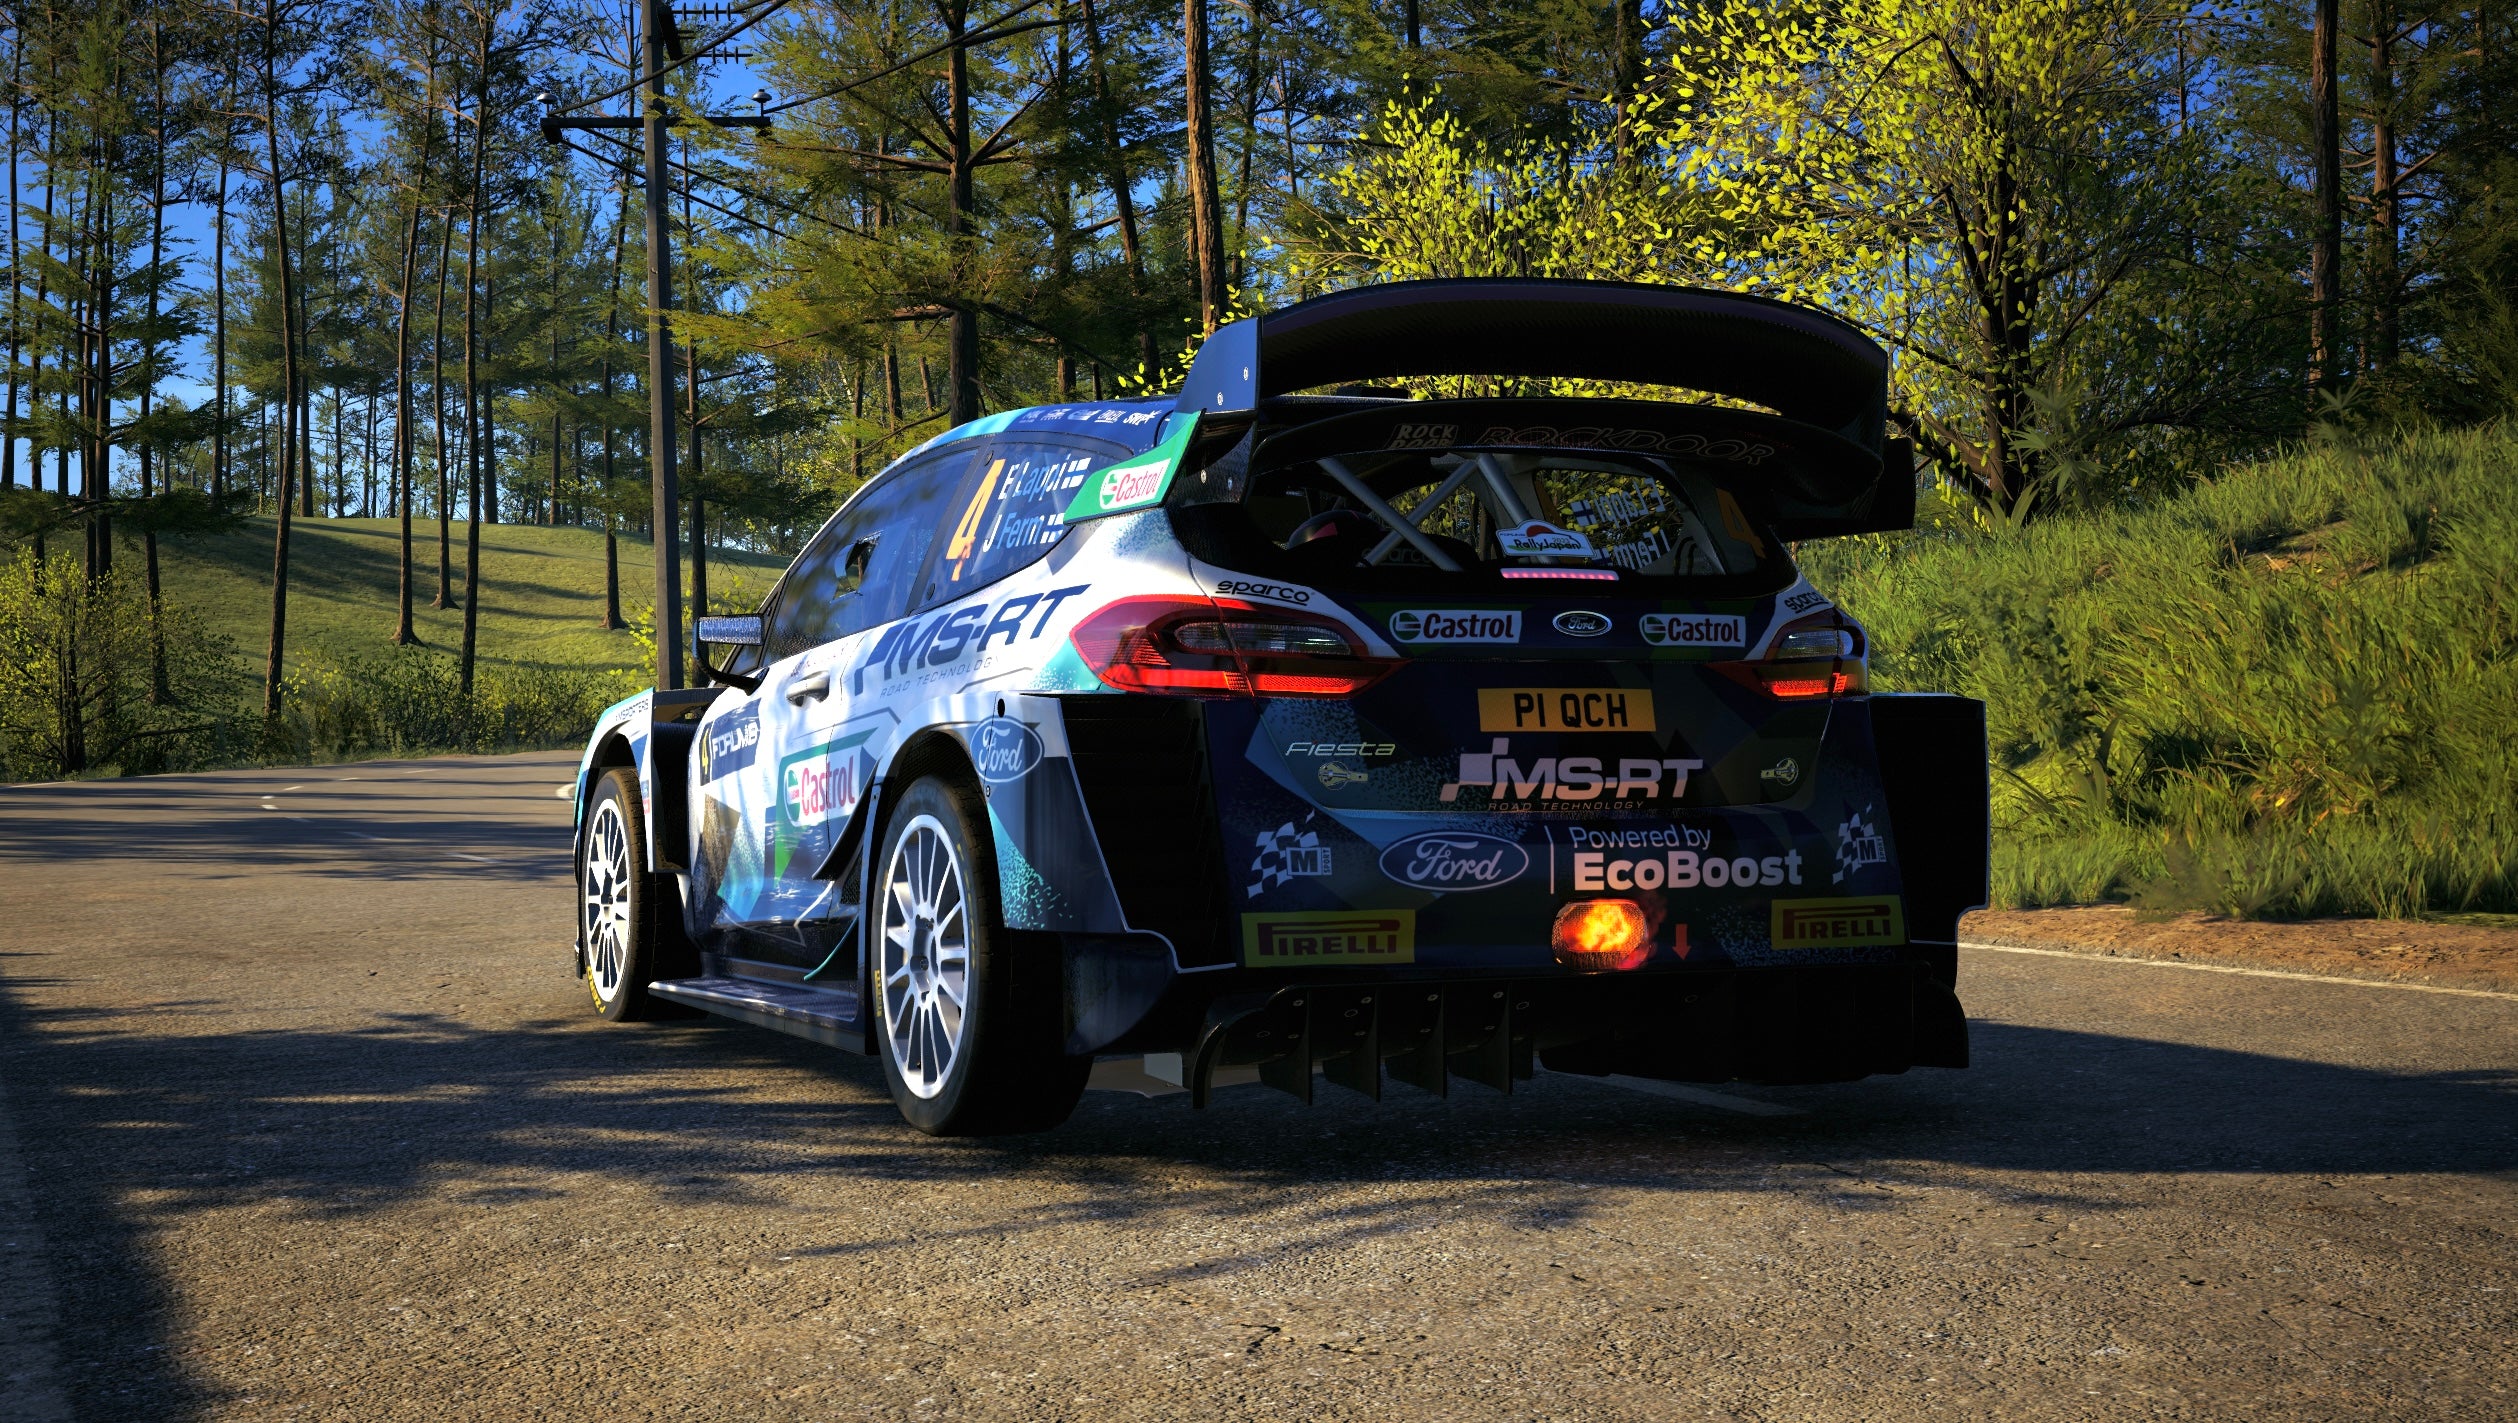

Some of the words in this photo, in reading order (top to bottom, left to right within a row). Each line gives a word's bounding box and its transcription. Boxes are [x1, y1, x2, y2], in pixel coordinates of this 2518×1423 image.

[1399, 424, 1456, 439] ROCK
[998, 463, 1020, 500] E
[1012, 453, 1071, 502] Lappi
[1116, 466, 1163, 503] Castrol
[946, 459, 1005, 581] 4
[983, 514, 1002, 553] J
[997, 512, 1045, 549] Ferm
[1216, 580, 1310, 606] sparco
[1423, 612, 1514, 640] Castrol
[1569, 614, 1597, 631] Ford
[1667, 615, 1742, 643] Castrol
[1560, 693, 1628, 728] QCH
[978, 725, 1024, 772] Ford
[1285, 740, 1397, 757] Fiesta
[801, 755, 856, 817] Castrol
[1488, 802, 1533, 812] ROAD
[1543, 800, 1645, 811] TECHNOLOGY
[1569, 823, 1681, 849] Powered
[1683, 824, 1713, 851] by
[1406, 839, 1504, 882] Ford
[1573, 848, 1803, 892] EcoBoost
[1257, 919, 1401, 956] PIRELLI
[1782, 904, 1891, 940] PIRELLI
